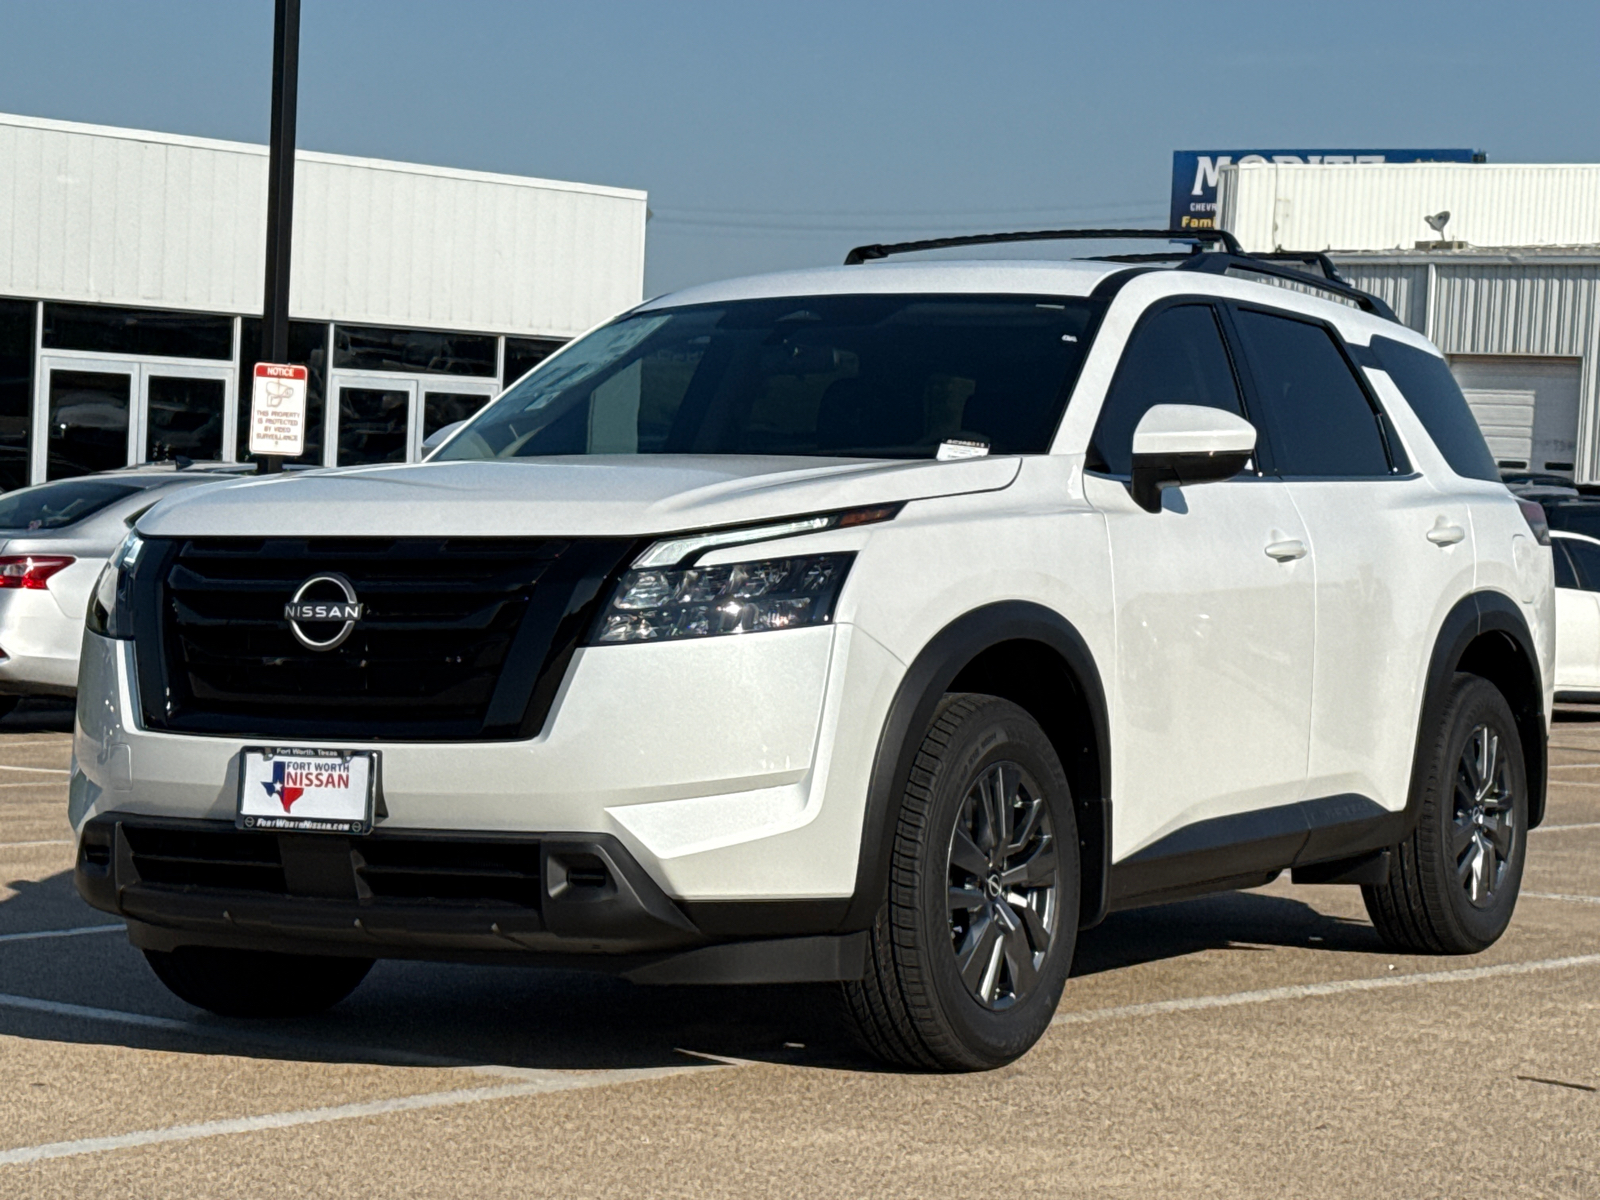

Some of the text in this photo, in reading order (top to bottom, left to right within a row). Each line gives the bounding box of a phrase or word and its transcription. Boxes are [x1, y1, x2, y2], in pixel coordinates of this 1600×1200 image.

[1190, 202, 1217, 212] CHEVR
[1181, 216, 1216, 228] Fami
[267, 367, 295, 377] NOTICE
[256, 433, 298, 441] SURVEILLANCE
[285, 605, 359, 618] NISSAN
[286, 761, 350, 773] FORT WORTH
[286, 772, 350, 789] NISSAN
